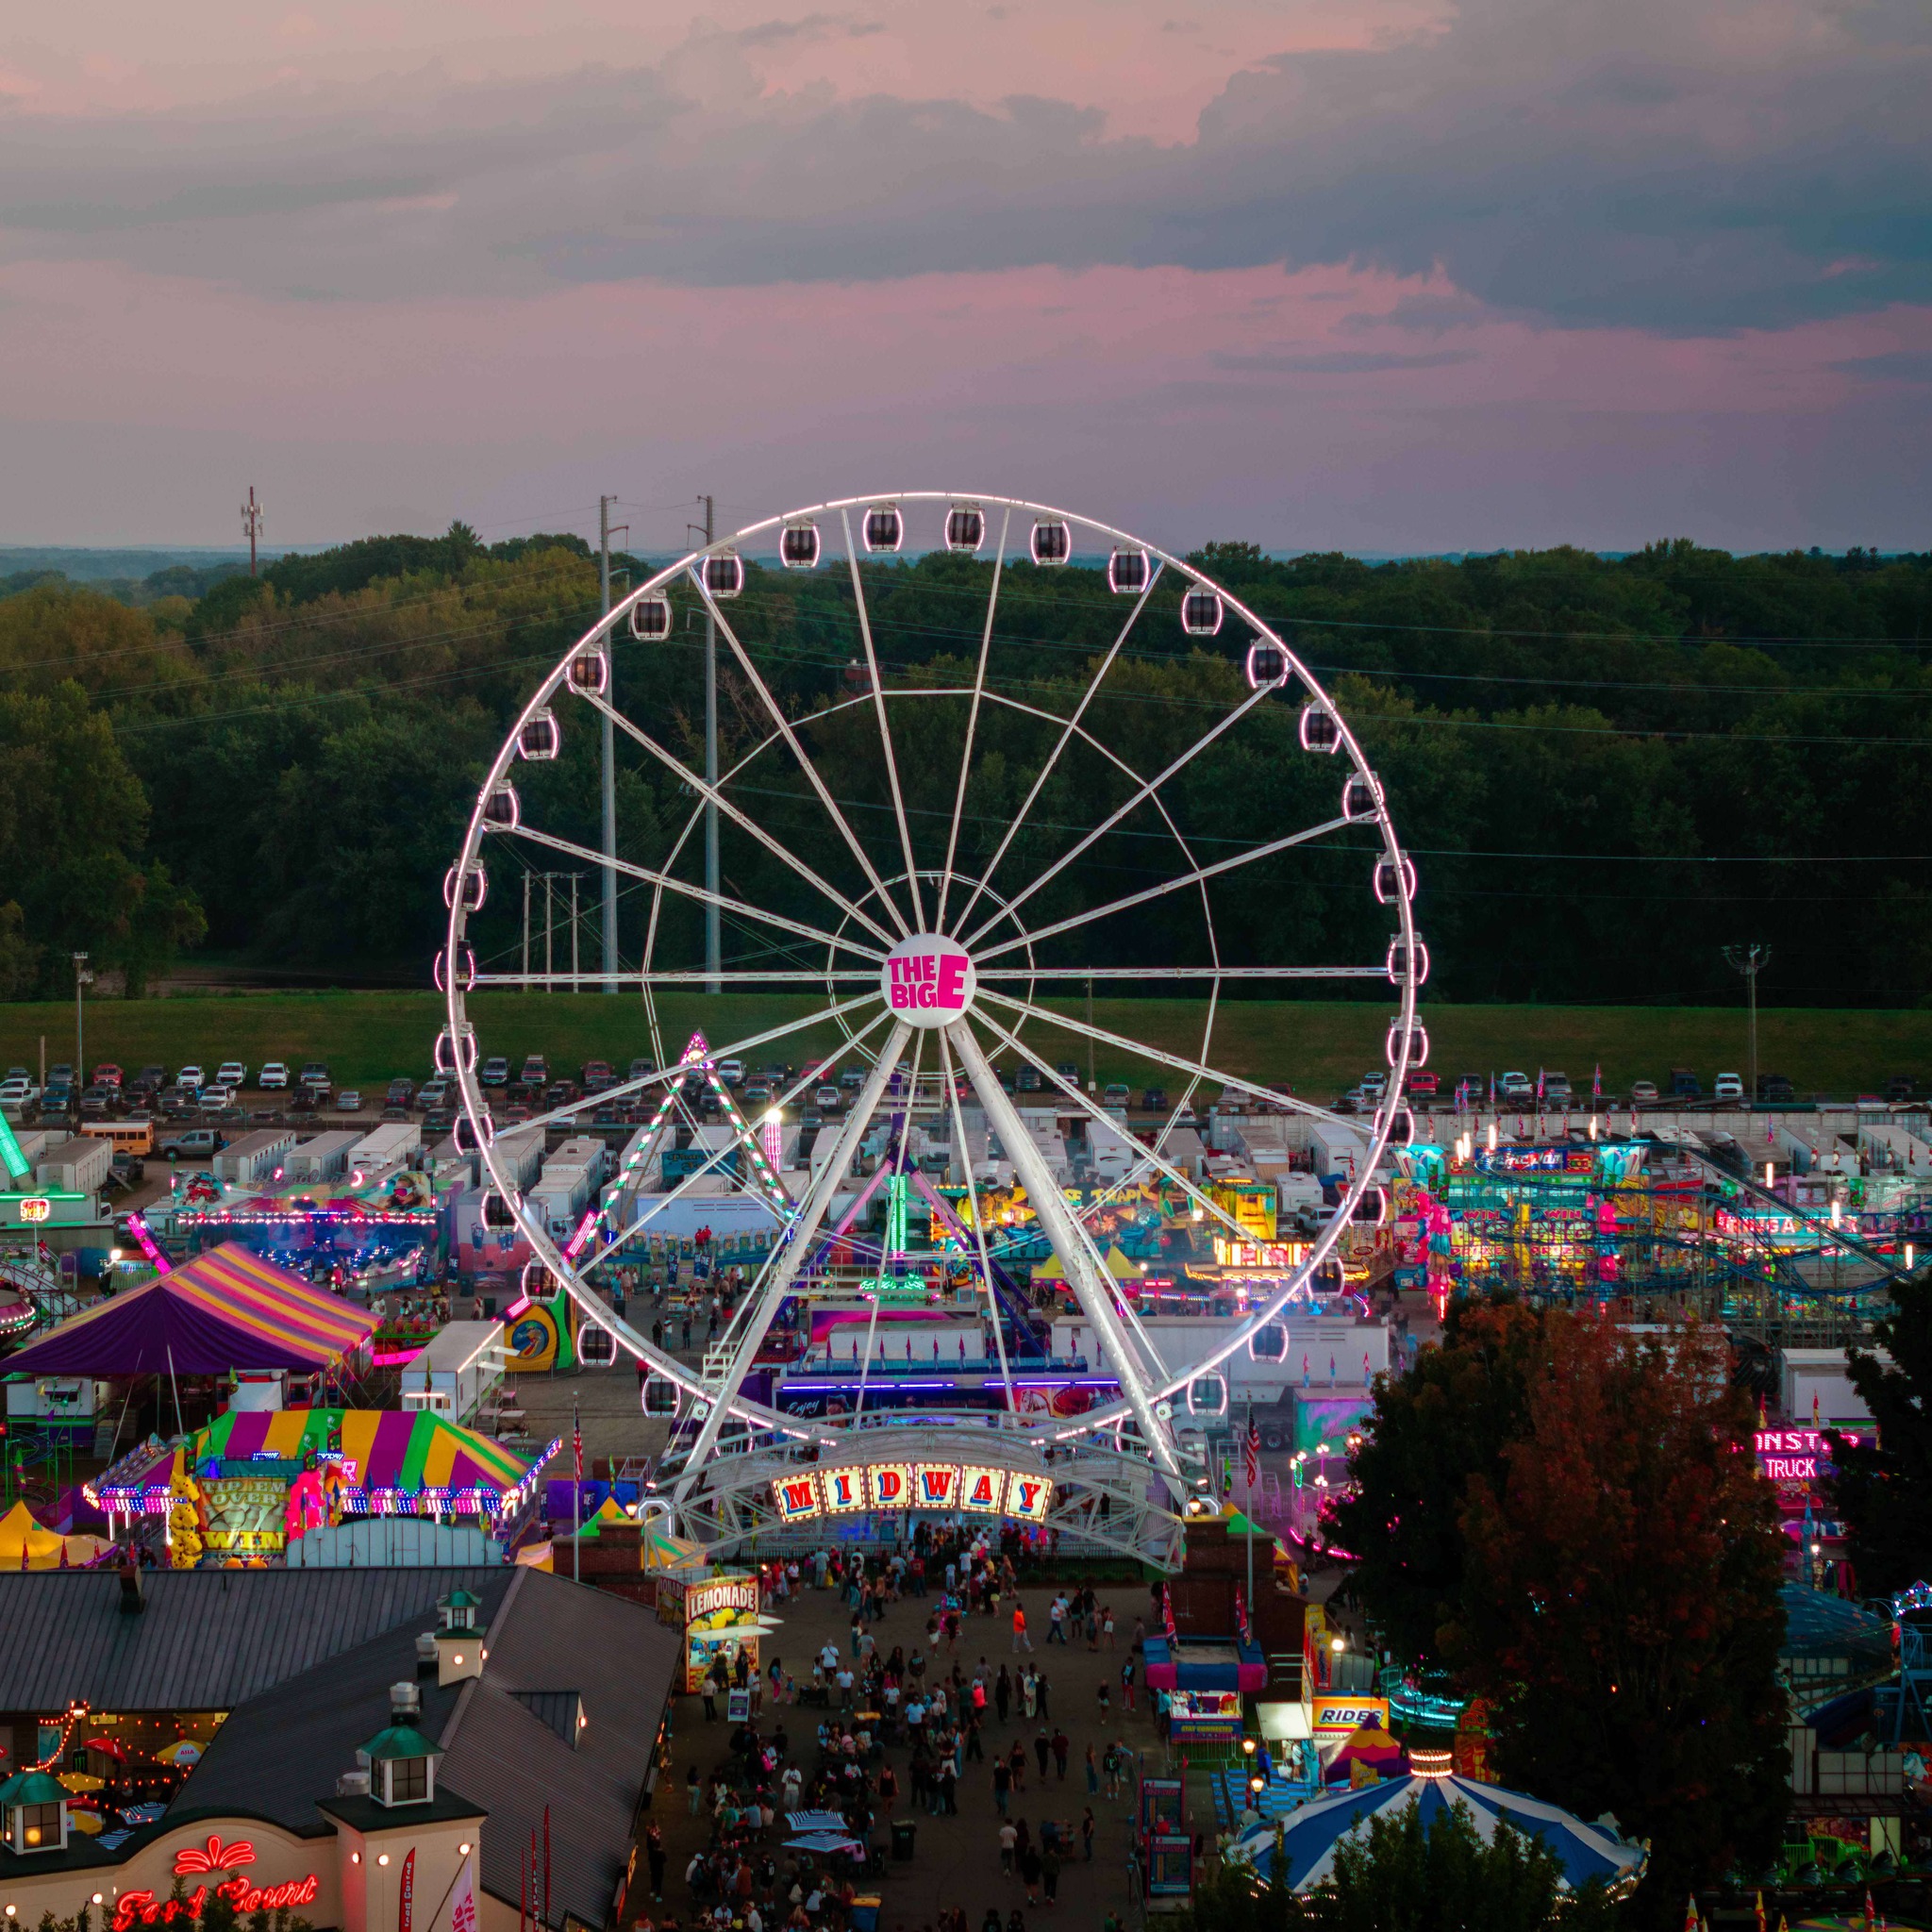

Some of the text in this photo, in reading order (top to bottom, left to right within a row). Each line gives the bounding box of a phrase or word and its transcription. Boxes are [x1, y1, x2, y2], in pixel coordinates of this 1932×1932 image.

[888, 954, 968, 1009] THE E
[891, 982, 938, 1008] BIG
[1544, 1209, 1582, 1221] WIN
[1765, 1457, 1816, 1478] TRUCK
[201, 1481, 242, 1493] TIP
[781, 1471, 1041, 1515] MIDWAY
[211, 1492, 277, 1505] OVER
[202, 1531, 287, 1550] WIN
[691, 1586, 755, 1617] LEMONADE
[1320, 1707, 1384, 1724] RIDES
